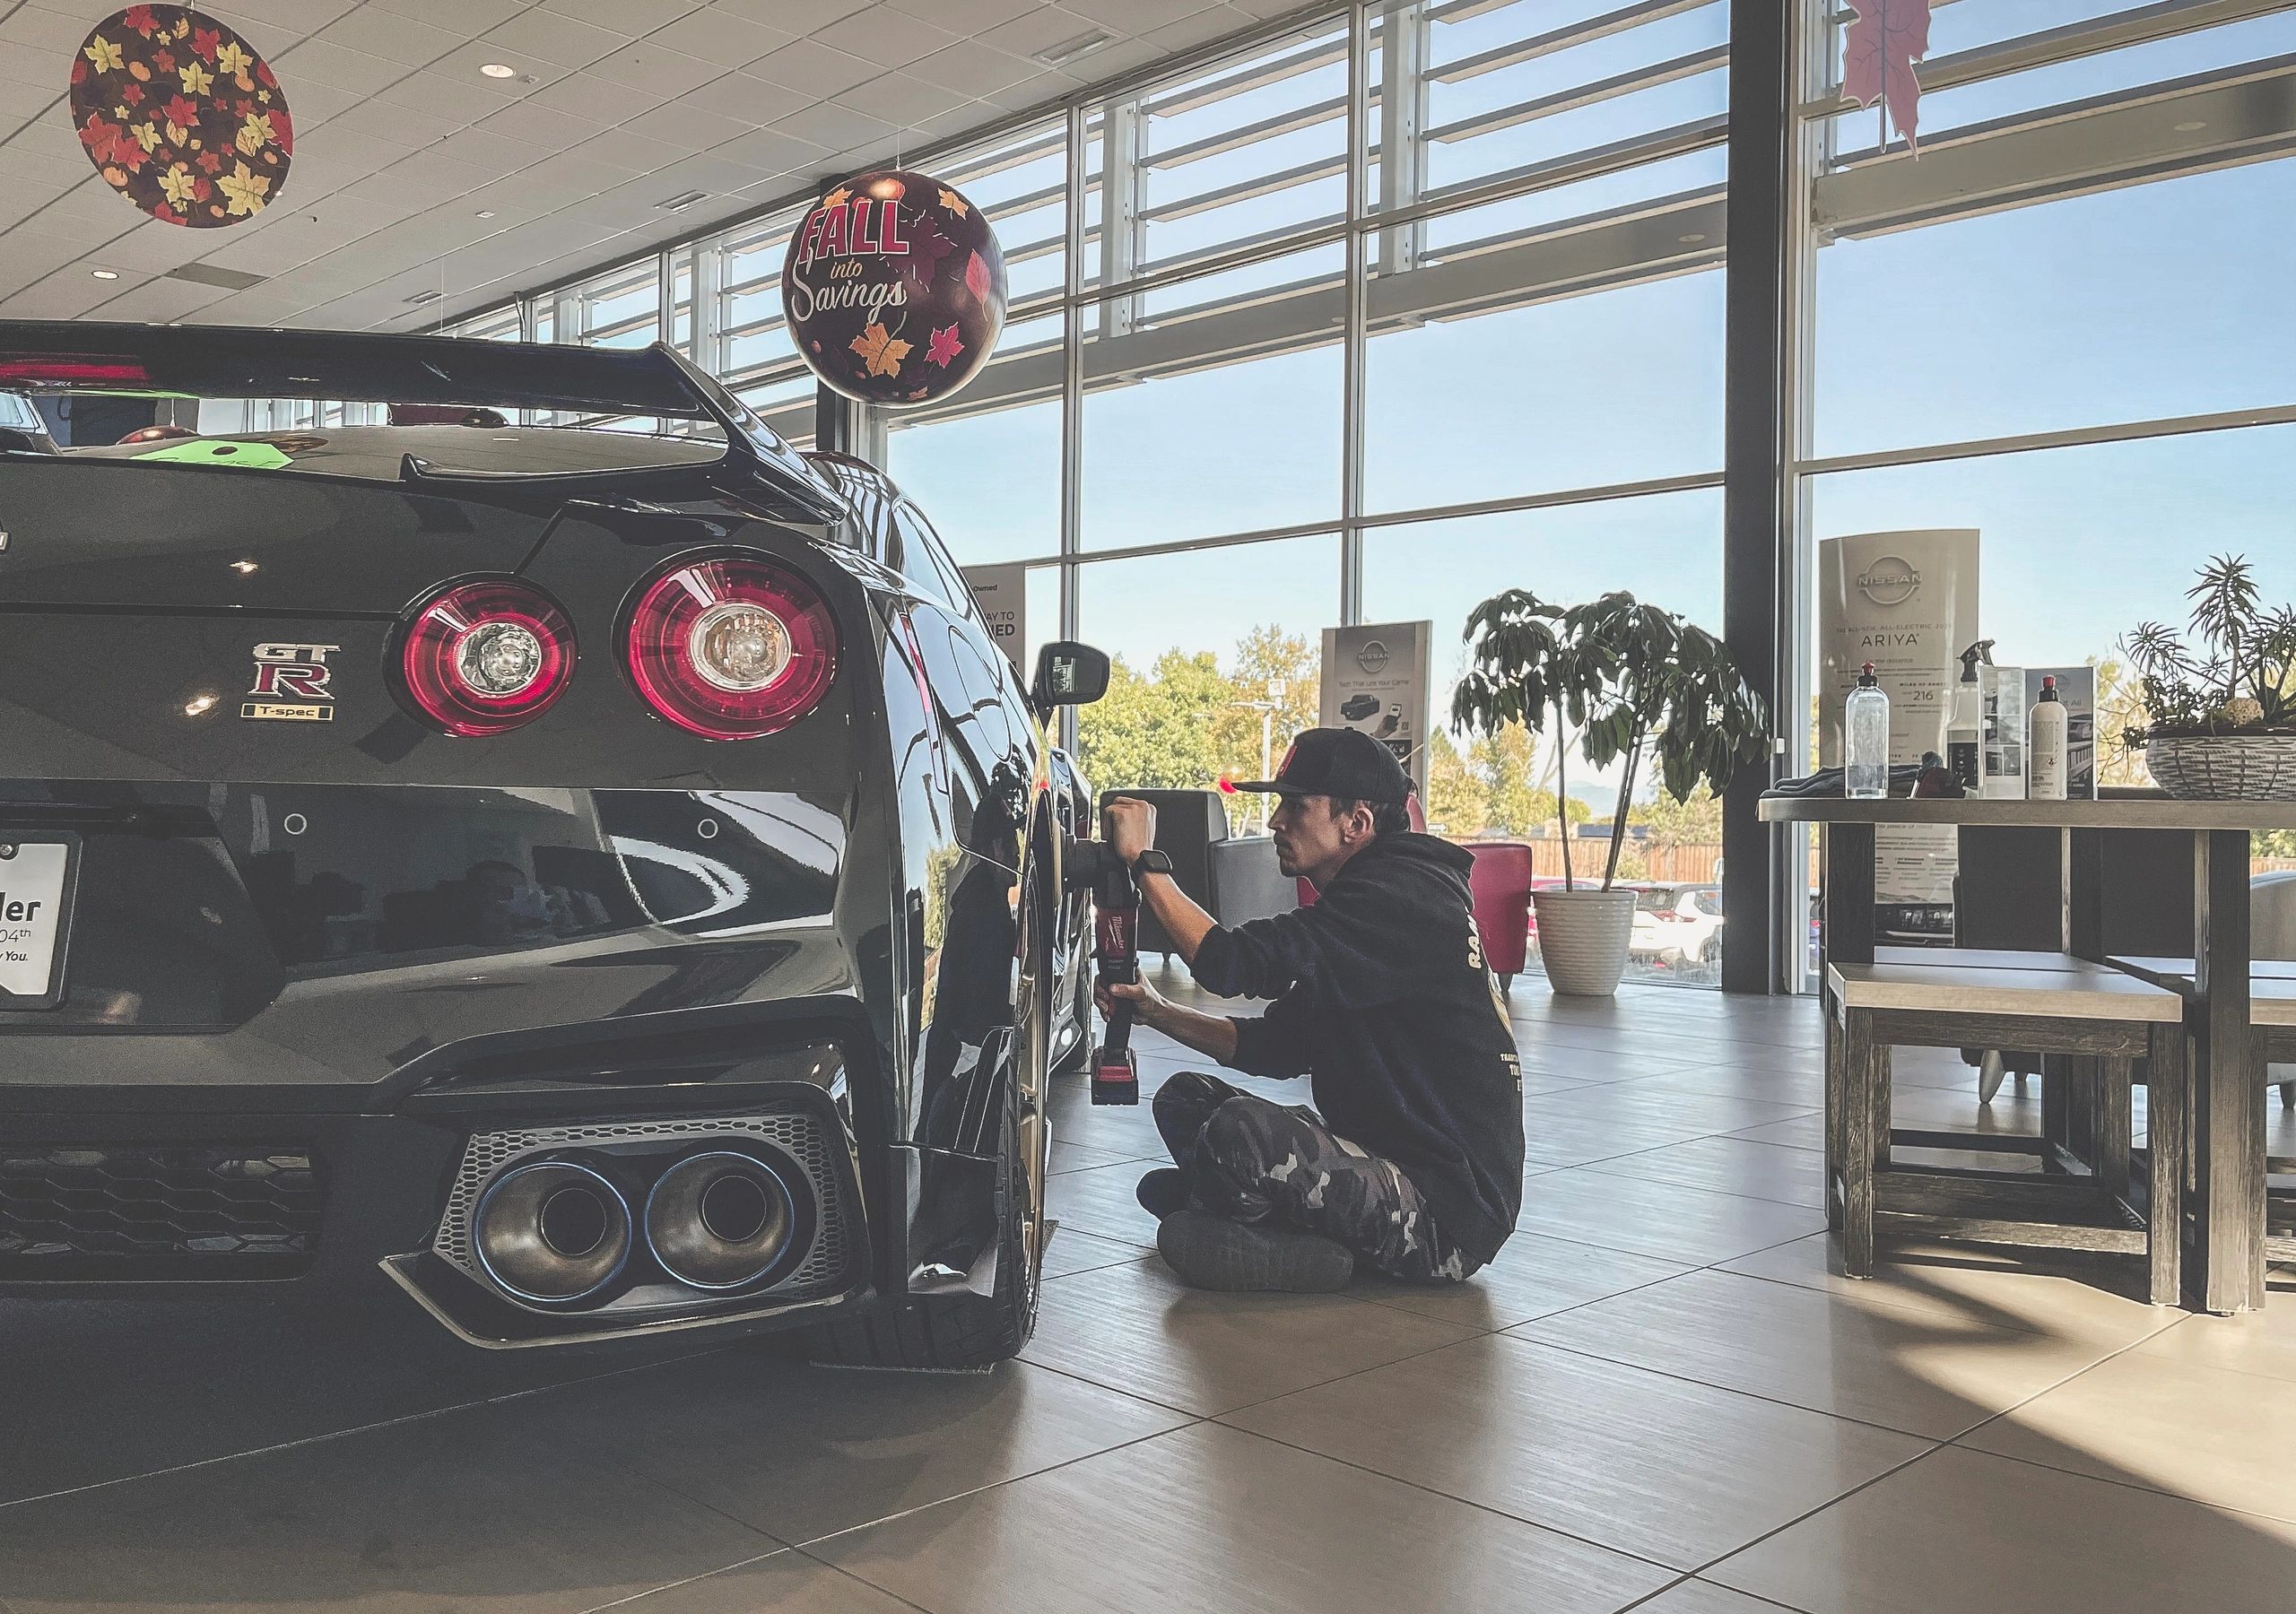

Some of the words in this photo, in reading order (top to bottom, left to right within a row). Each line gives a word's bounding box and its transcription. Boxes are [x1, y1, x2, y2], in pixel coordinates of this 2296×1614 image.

[798, 199, 909, 265] FALL
[830, 258, 864, 280] into
[791, 247, 907, 324] Savings
[1858, 573, 1923, 586] NISSAN
[1000, 611, 1015, 621] TO
[1861, 633, 1918, 647] ARIYA
[253, 643, 342, 664] GT
[1357, 653, 1390, 661] NISSAN
[248, 661, 335, 699] R
[1912, 690, 1935, 701] 216
[260, 706, 315, 717] T-spec
[5, 950, 29, 961] You.
